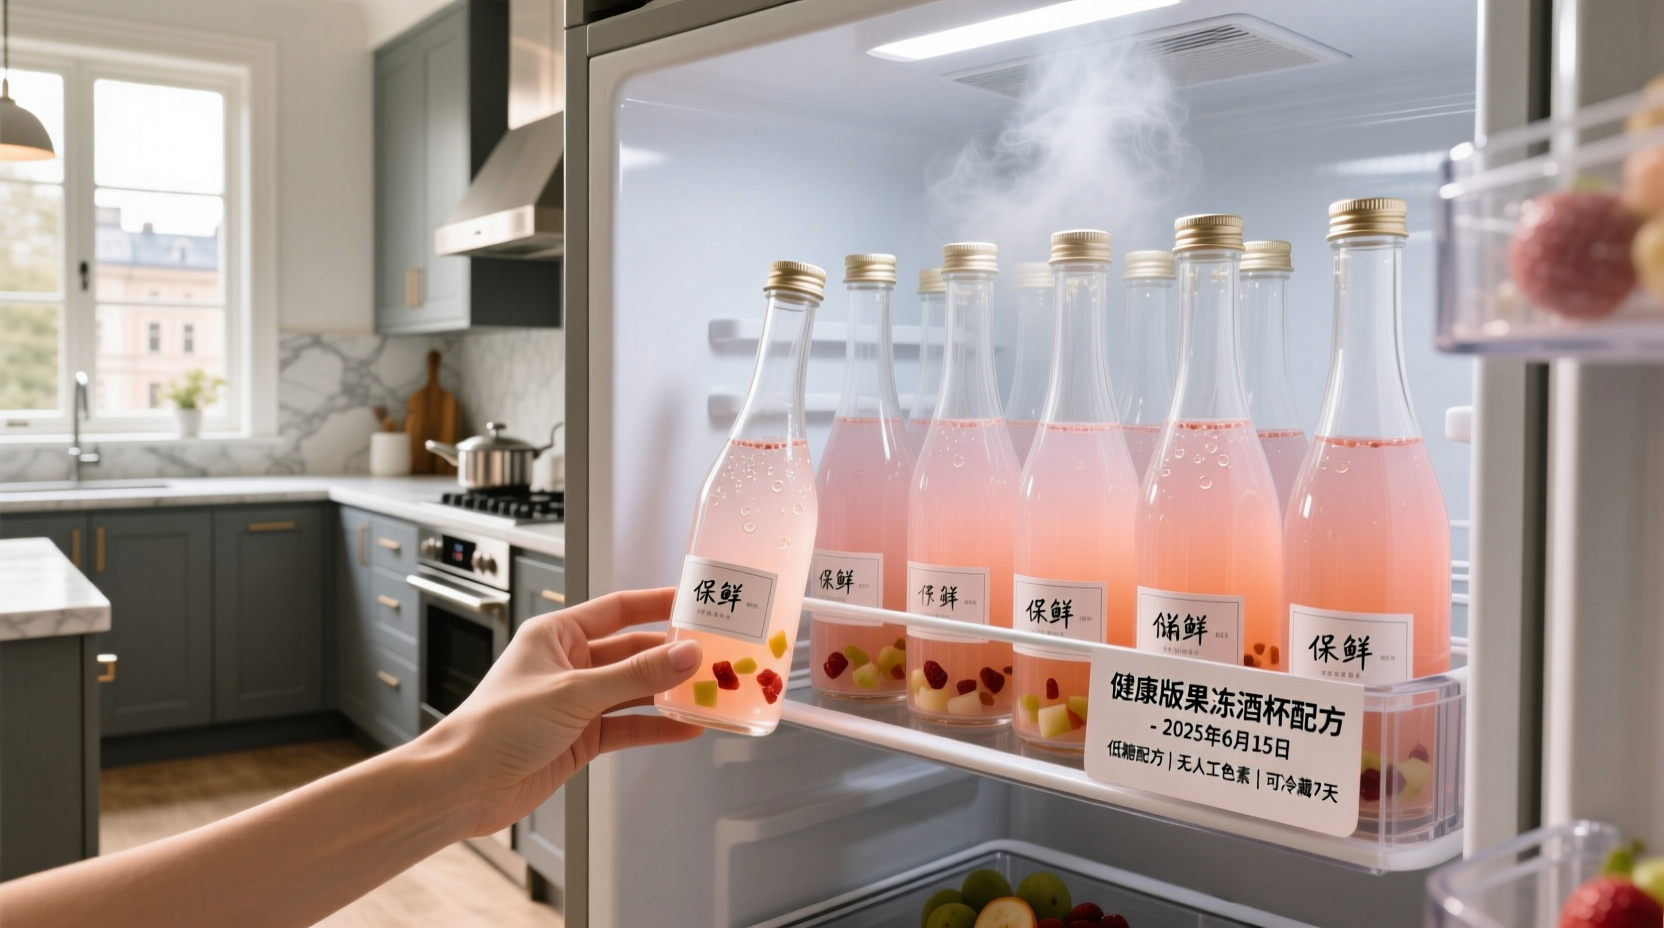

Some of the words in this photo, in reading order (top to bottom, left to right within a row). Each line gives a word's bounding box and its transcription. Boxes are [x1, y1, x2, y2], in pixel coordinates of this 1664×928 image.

[693, 579, 743, 613] 保鲜
[819, 569, 855, 595] 保鲜
[1025, 598, 1074, 630] 保鲜
[1308, 634, 1373, 672] 保鲜
[1110, 671, 1346, 737] 健康版果冻酒杯配方
[1162, 718, 1290, 761] 2025年6月15日
